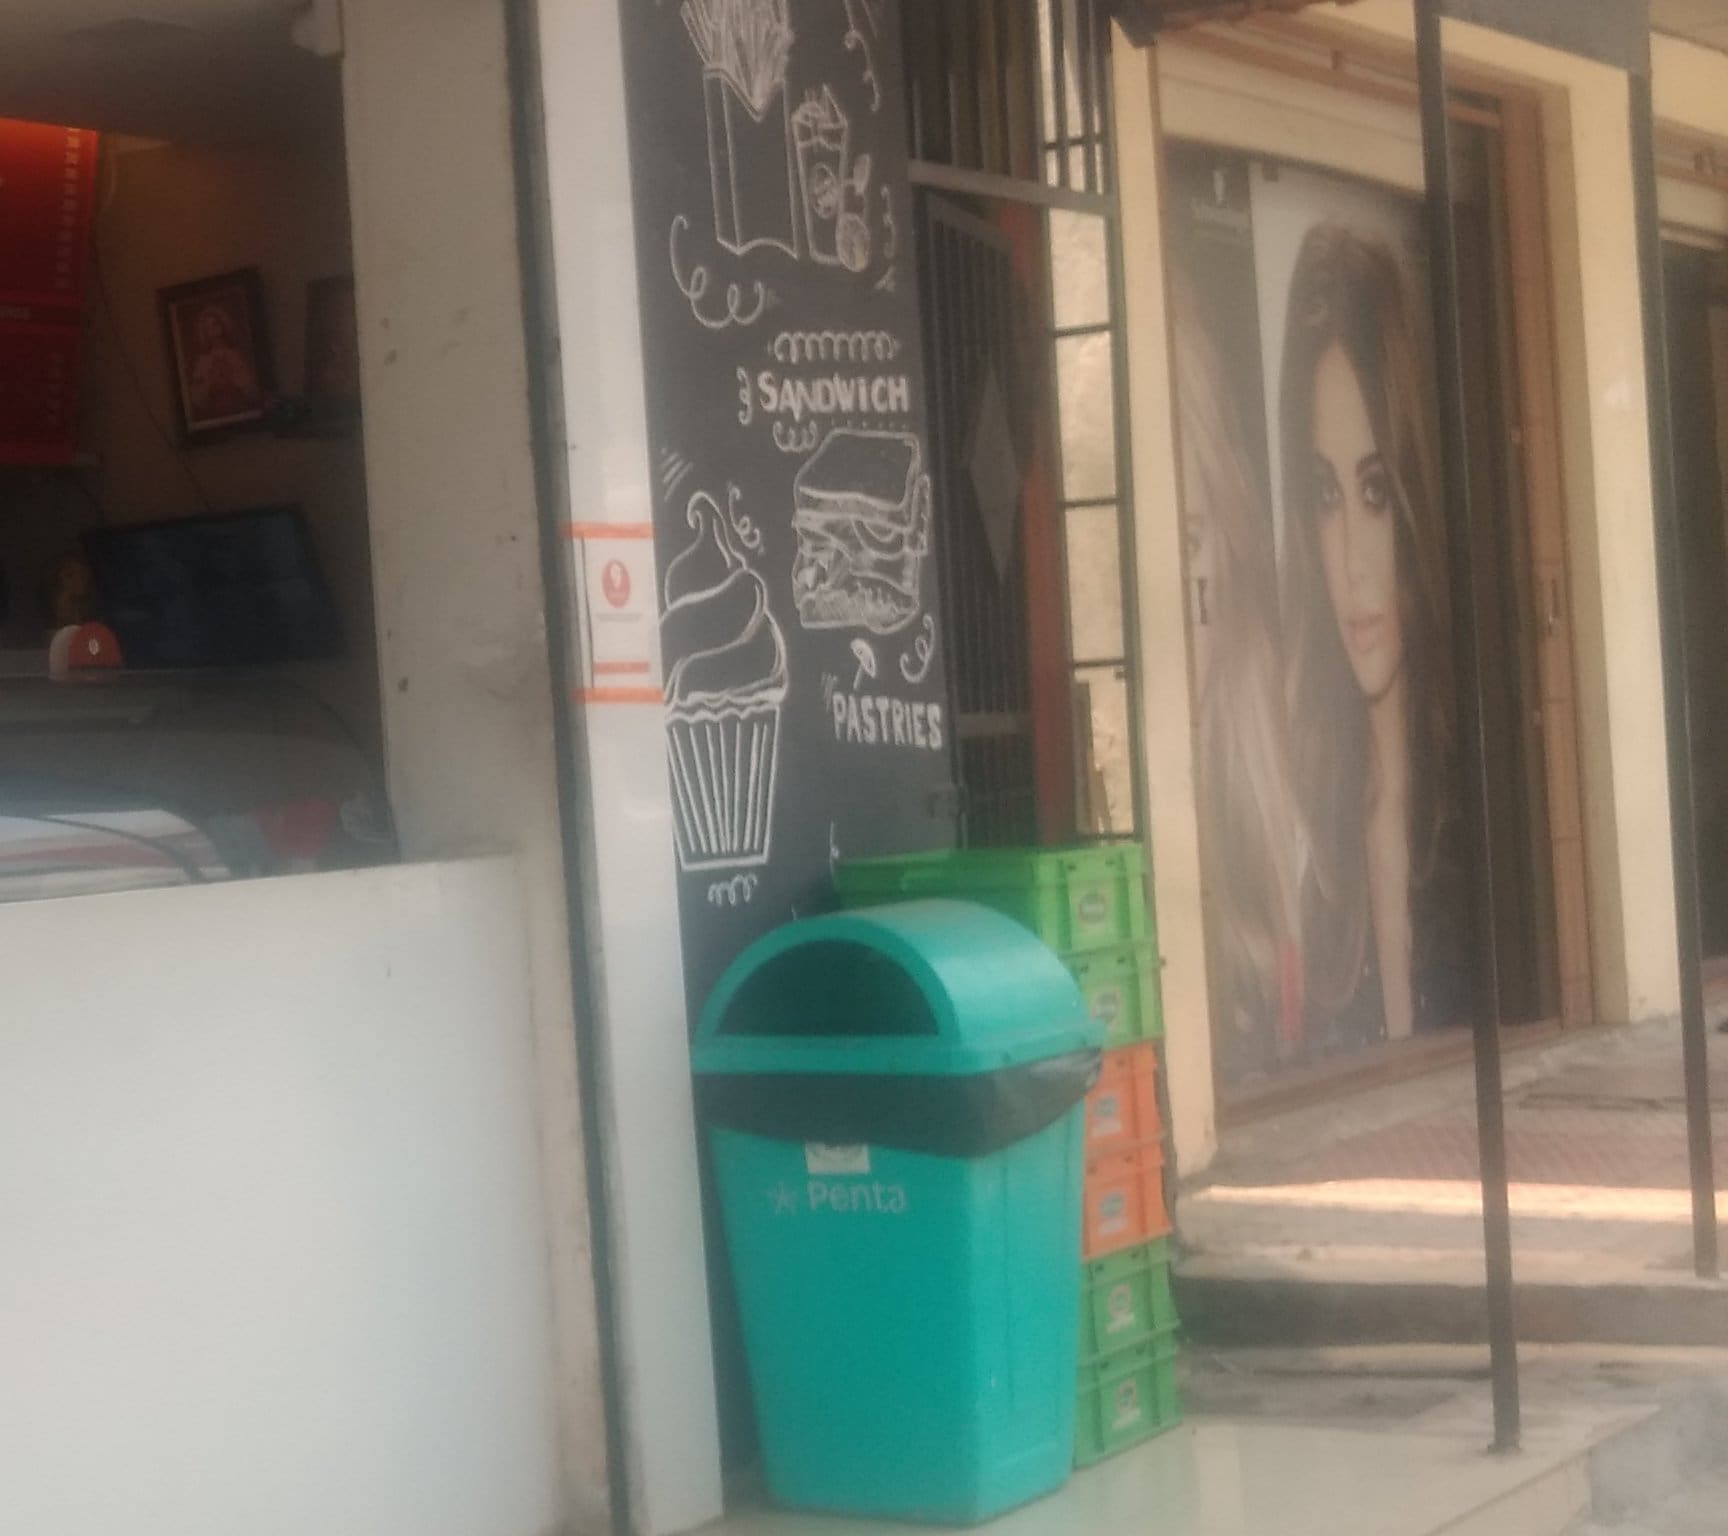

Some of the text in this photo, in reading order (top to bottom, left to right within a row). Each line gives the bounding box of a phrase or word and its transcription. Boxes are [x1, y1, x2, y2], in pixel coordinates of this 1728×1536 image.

[756, 369, 912, 422] SANDWICH
[831, 691, 943, 750] PASTRIES
[806, 1178, 909, 1216] Penta
